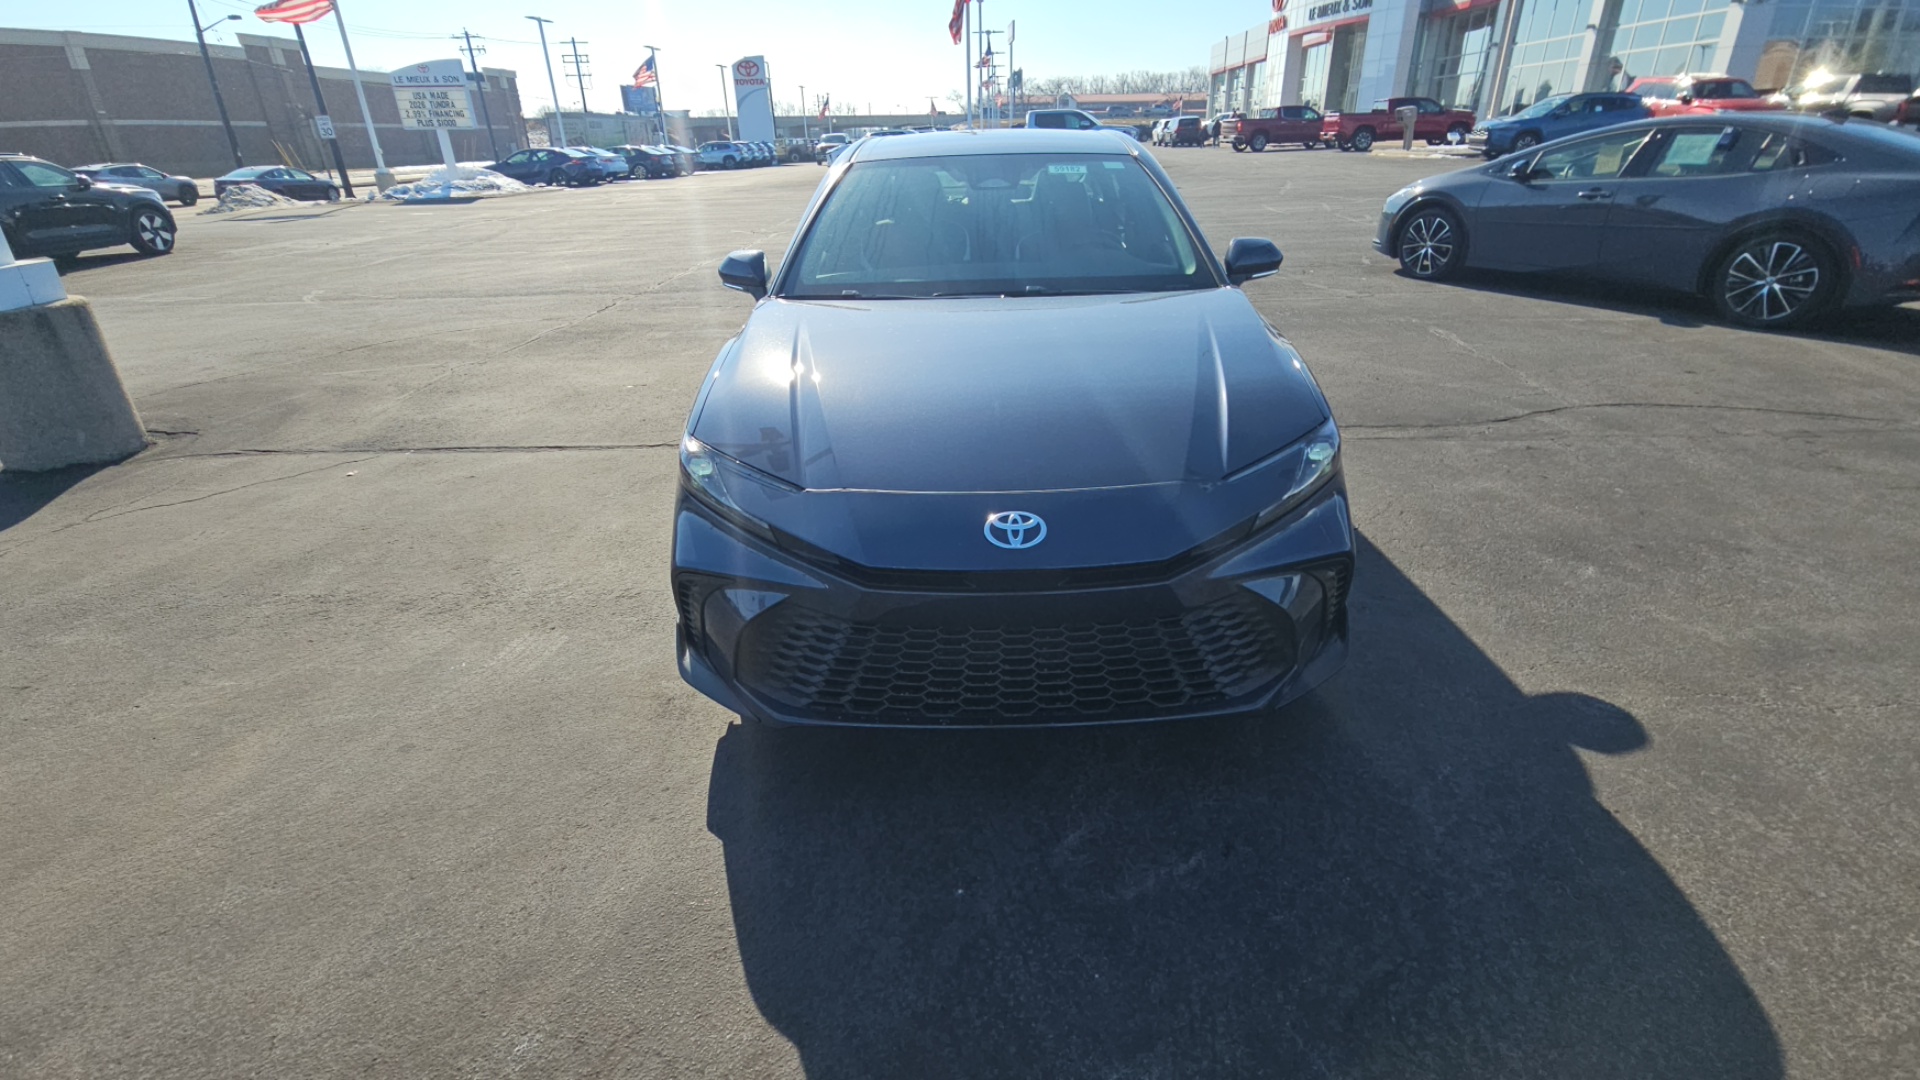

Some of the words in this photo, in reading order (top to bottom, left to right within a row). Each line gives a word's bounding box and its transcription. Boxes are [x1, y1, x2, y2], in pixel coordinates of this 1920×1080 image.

[1308, 6, 1317, 21] LE
[1343, 0, 1350, 12] &
[393, 75, 404, 84] LE
[406, 75, 430, 84] MIEUX
[433, 75, 440, 84] &
[441, 75, 460, 84] SON
[735, 78, 765, 86] TOYOTA
[412, 91, 427, 100] USA
[429, 91, 450, 100] MADE
[409, 100, 427, 109] 2026
[429, 100, 456, 109] TUNDRA
[428, 109, 465, 118] FINANCING
[416, 119, 434, 127] PLUS
[437, 119, 457, 127] $1000
[321, 127, 333, 136] 30
